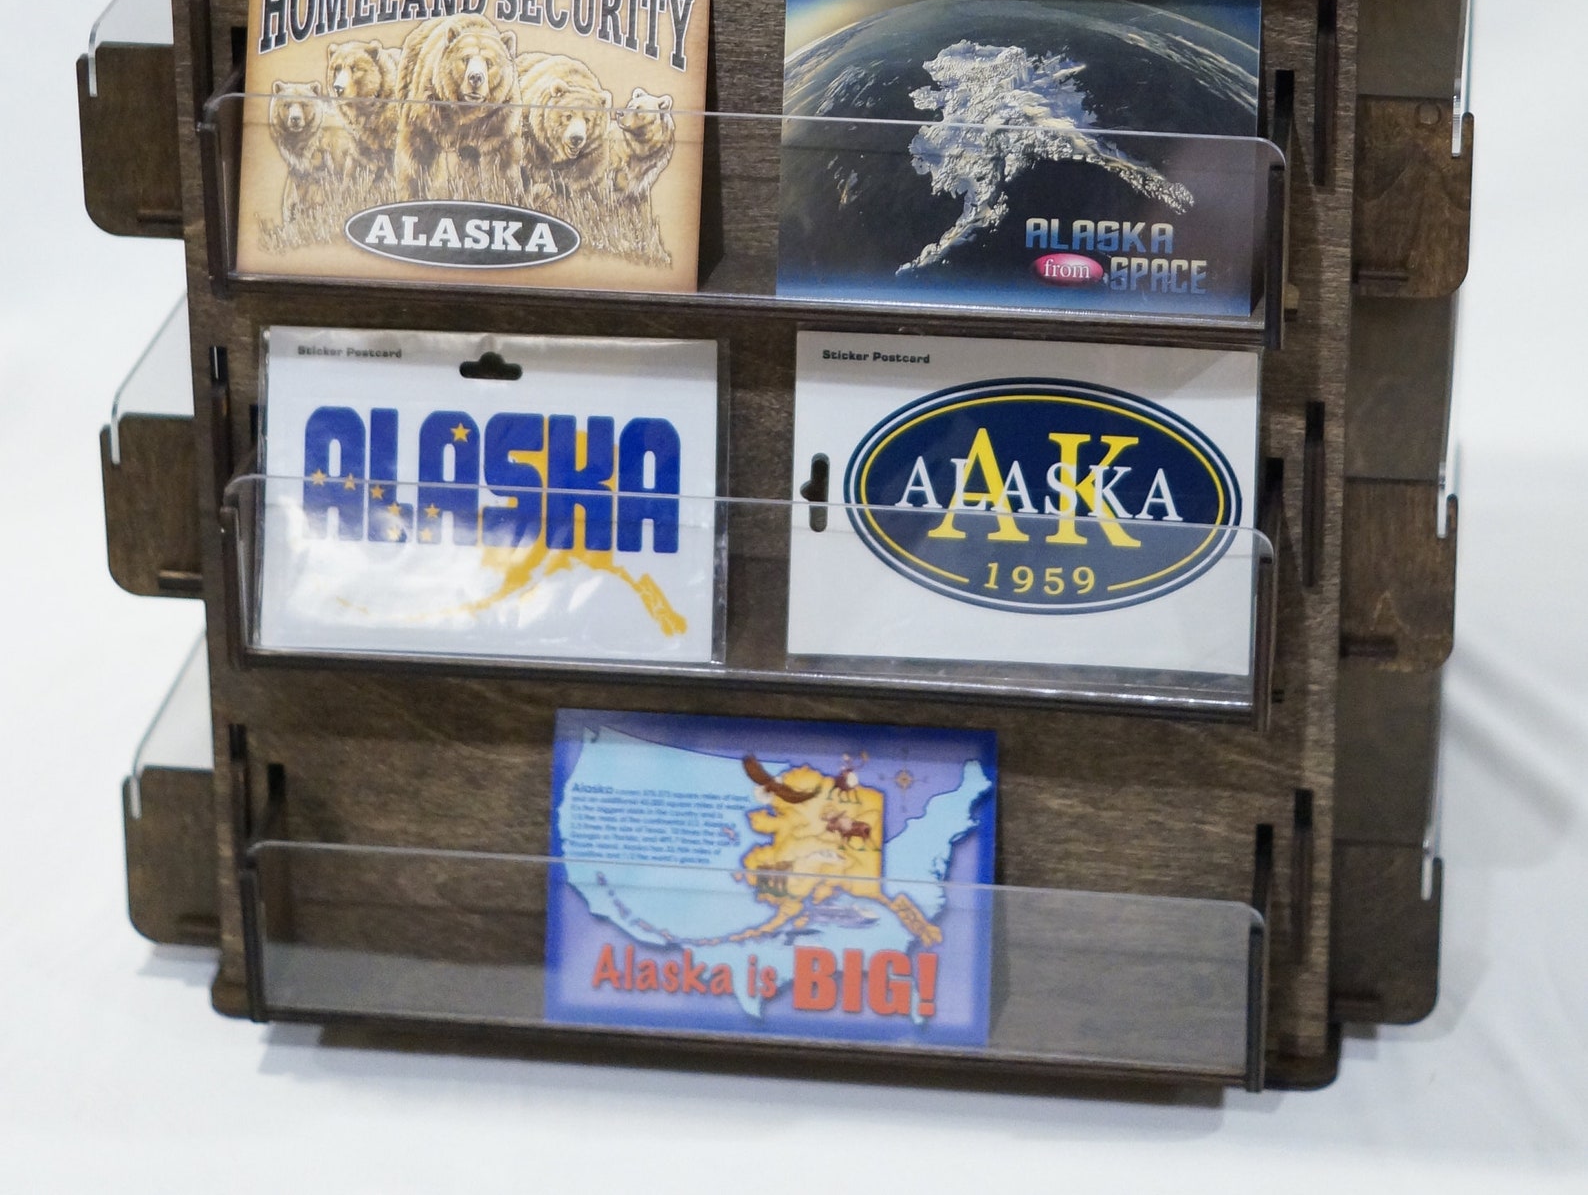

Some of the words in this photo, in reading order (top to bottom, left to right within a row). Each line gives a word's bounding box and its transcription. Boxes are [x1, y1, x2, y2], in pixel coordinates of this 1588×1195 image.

[365, 214, 558, 253] ALASKA
[1025, 217, 1175, 254] ALASKA
[1043, 258, 1091, 280] from
[1109, 256, 1208, 295] SPACE
[297, 345, 343, 356] Sticker
[346, 347, 402, 358] Postcard
[822, 349, 870, 361] Sticker
[872, 351, 930, 364] Postcard
[302, 405, 681, 553] ALASKA
[896, 456, 1184, 521] ALASKA
[984, 562, 1096, 595] 1959
[592, 943, 733, 996] Alaska
[747, 955, 778, 998] is
[792, 945, 939, 1017] BIG!
